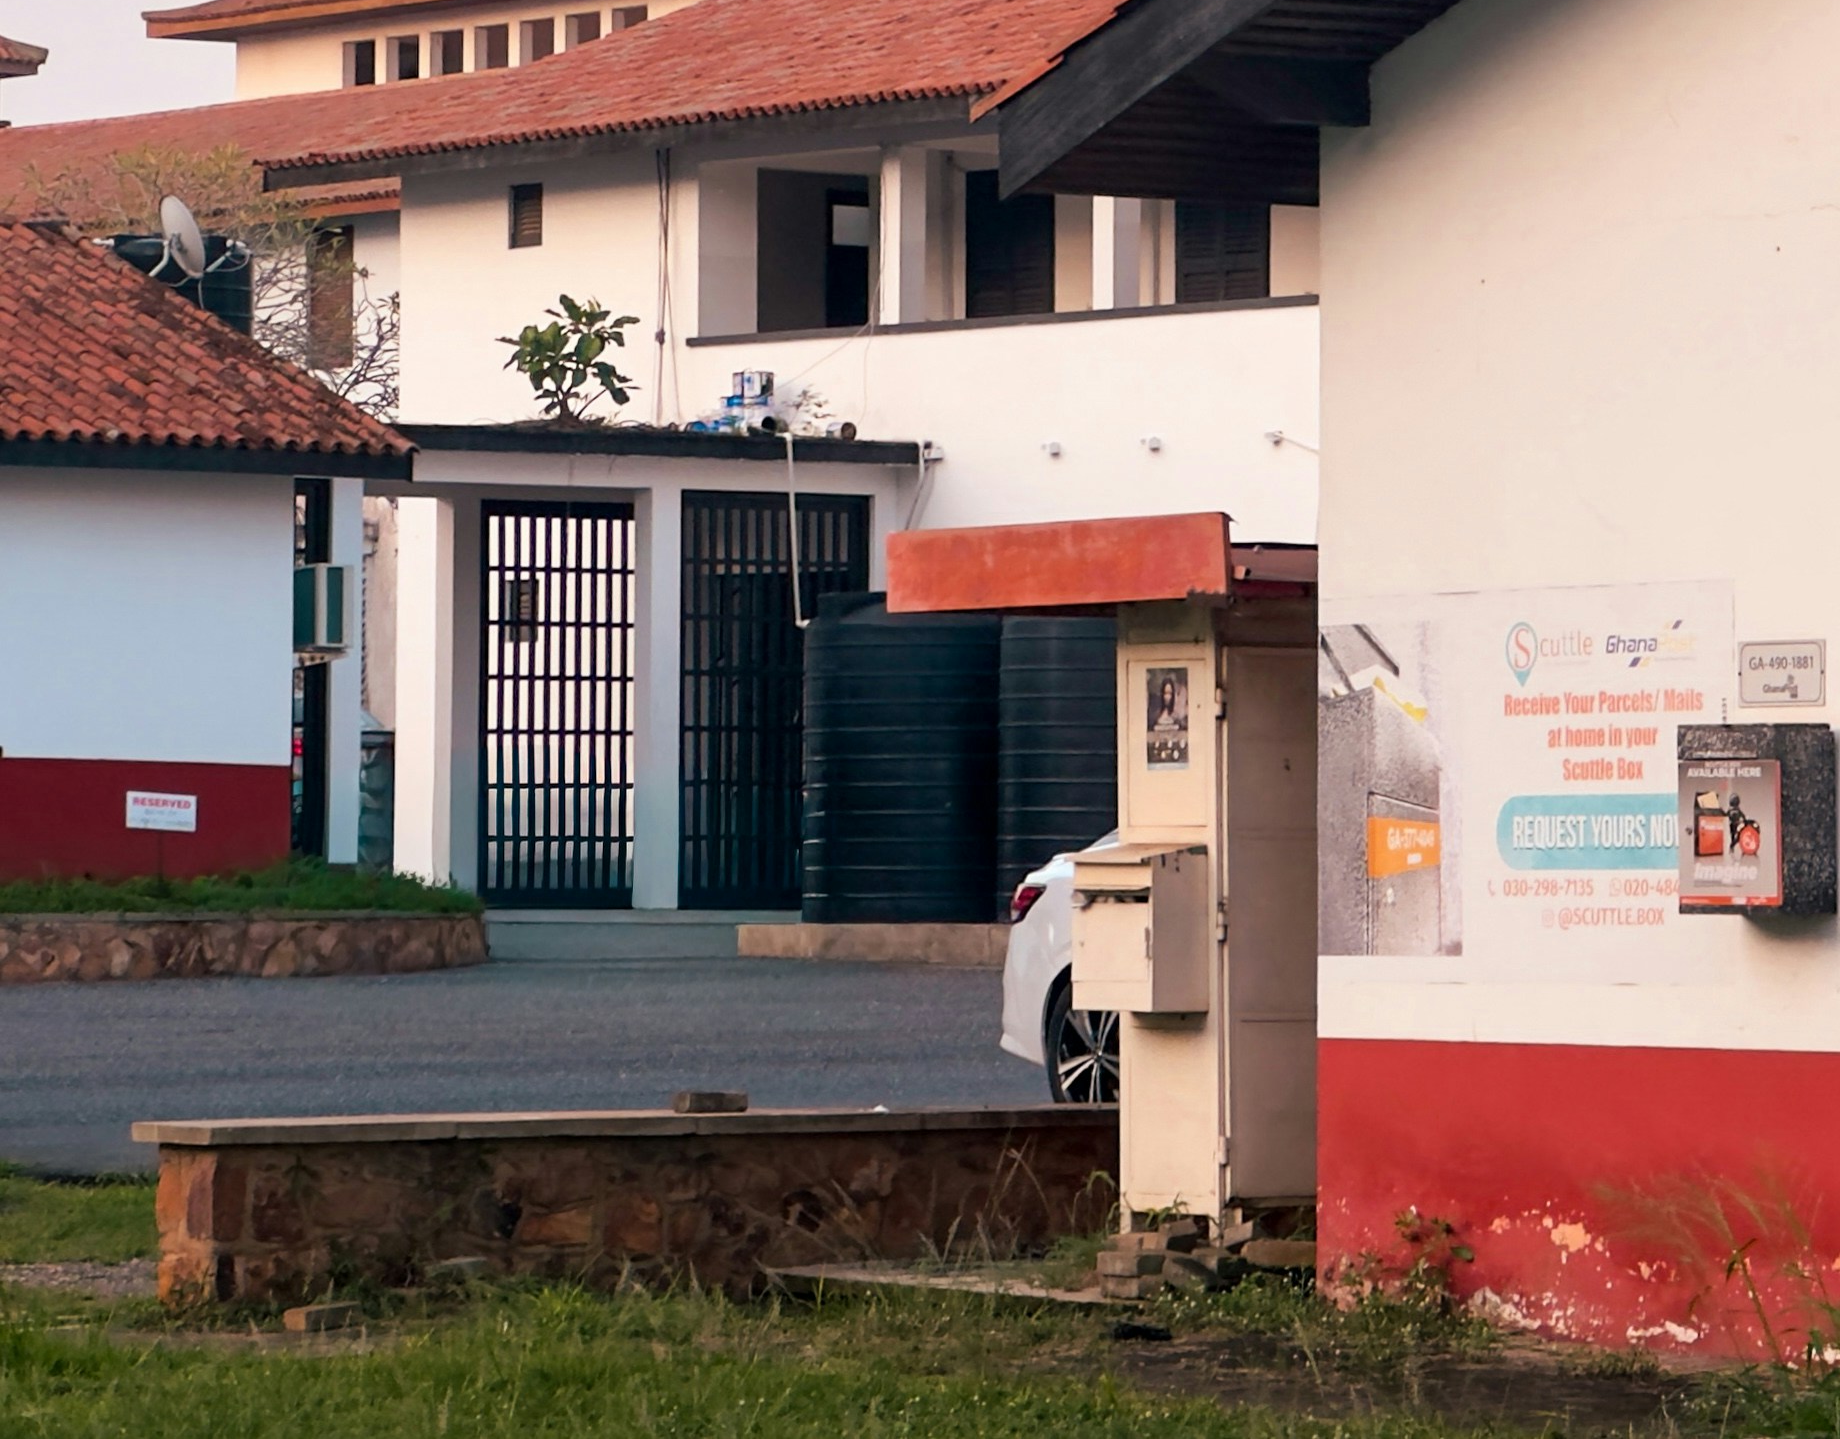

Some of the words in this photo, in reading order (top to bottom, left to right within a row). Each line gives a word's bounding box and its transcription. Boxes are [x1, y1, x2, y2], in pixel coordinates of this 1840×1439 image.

[1748, 655, 1814, 671] GA-490-1881
[1503, 693, 1560, 716] Receive
[1563, 691, 1595, 714] Your
[1598, 689, 1660, 713] Parcels/
[1663, 688, 1704, 712] Mails
[1547, 726, 1561, 748] at
[1565, 725, 1605, 747] home
[1608, 723, 1622, 747] in
[1626, 726, 1658, 749] your
[1562, 757, 1614, 781] Scuttle
[1617, 757, 1644, 780] Box
[132, 797, 191, 809] RESERVED
[1512, 814, 1587, 852] REQUEST
[1591, 813, 1647, 850] YOURS
[1649, 813, 1680, 850] NO
[1502, 877, 1594, 897] 030-298-7135
[1558, 907, 1665, 931] @SCUTTLE.BOX
